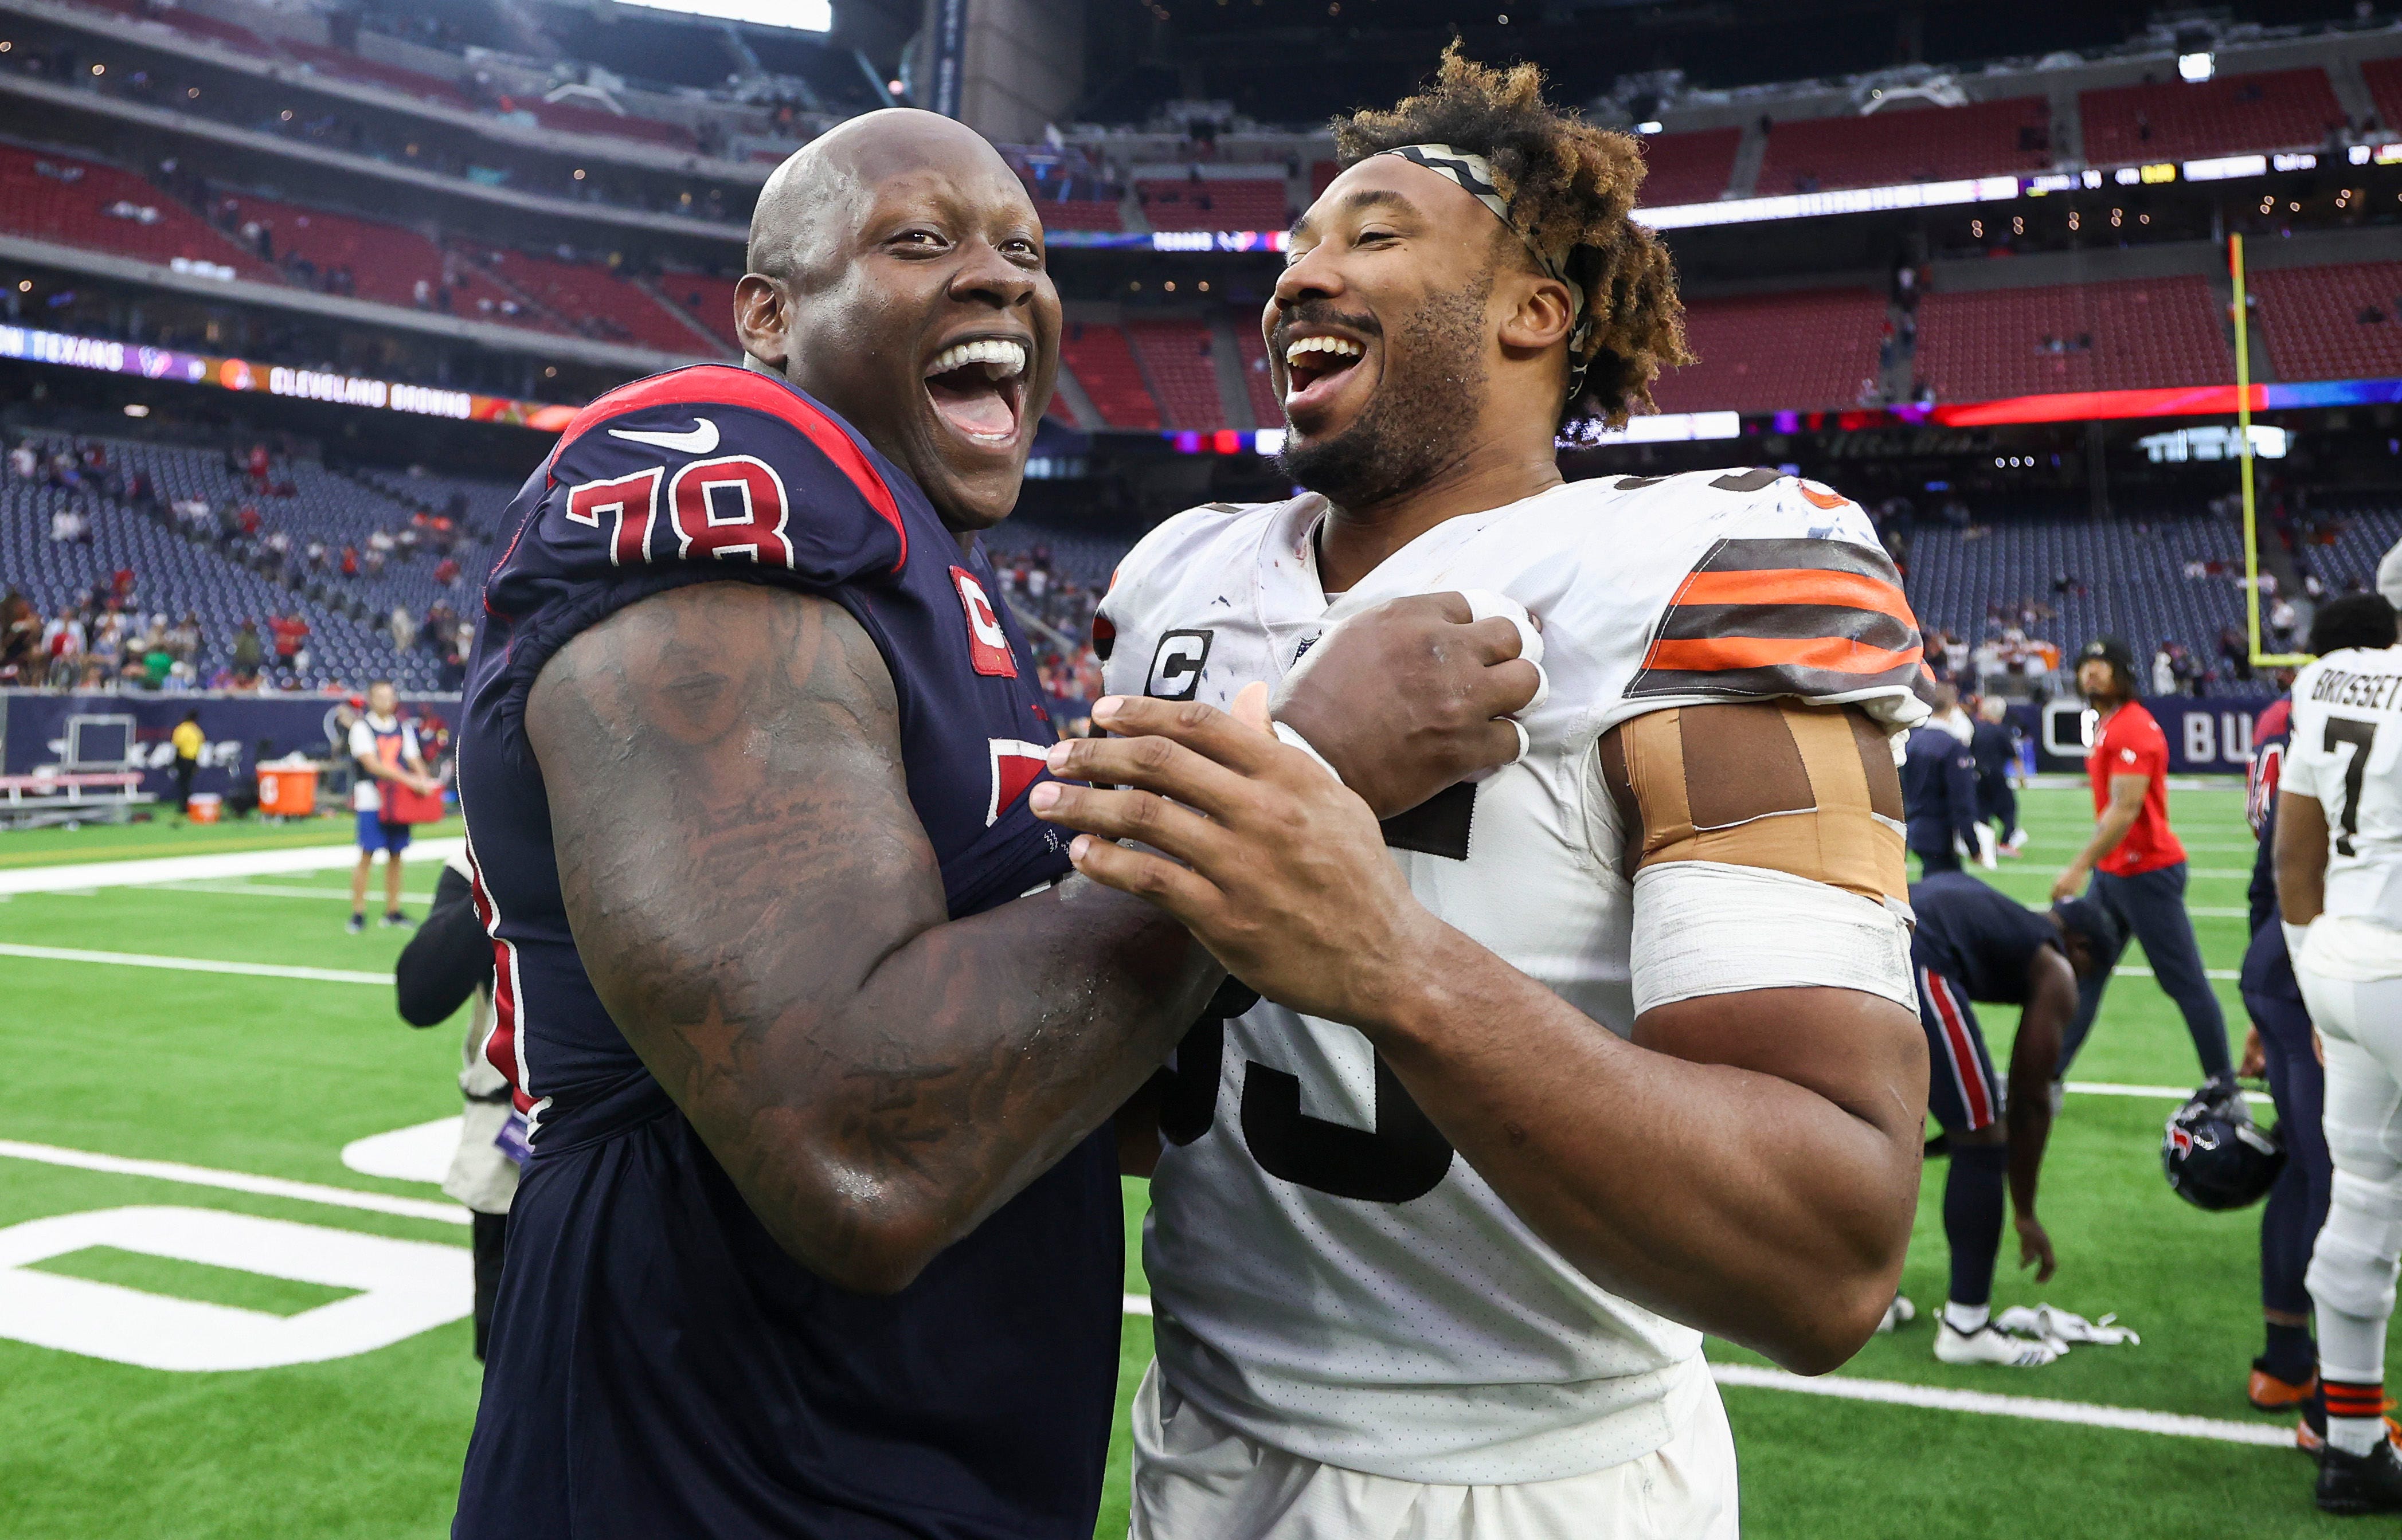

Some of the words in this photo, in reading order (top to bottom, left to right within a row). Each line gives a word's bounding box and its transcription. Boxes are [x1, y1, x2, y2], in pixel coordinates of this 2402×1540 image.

[565, 454, 796, 571] 78
[959, 574, 1006, 649] C
[1150, 635, 1204, 696] C
[2324, 716, 2376, 856] 7
